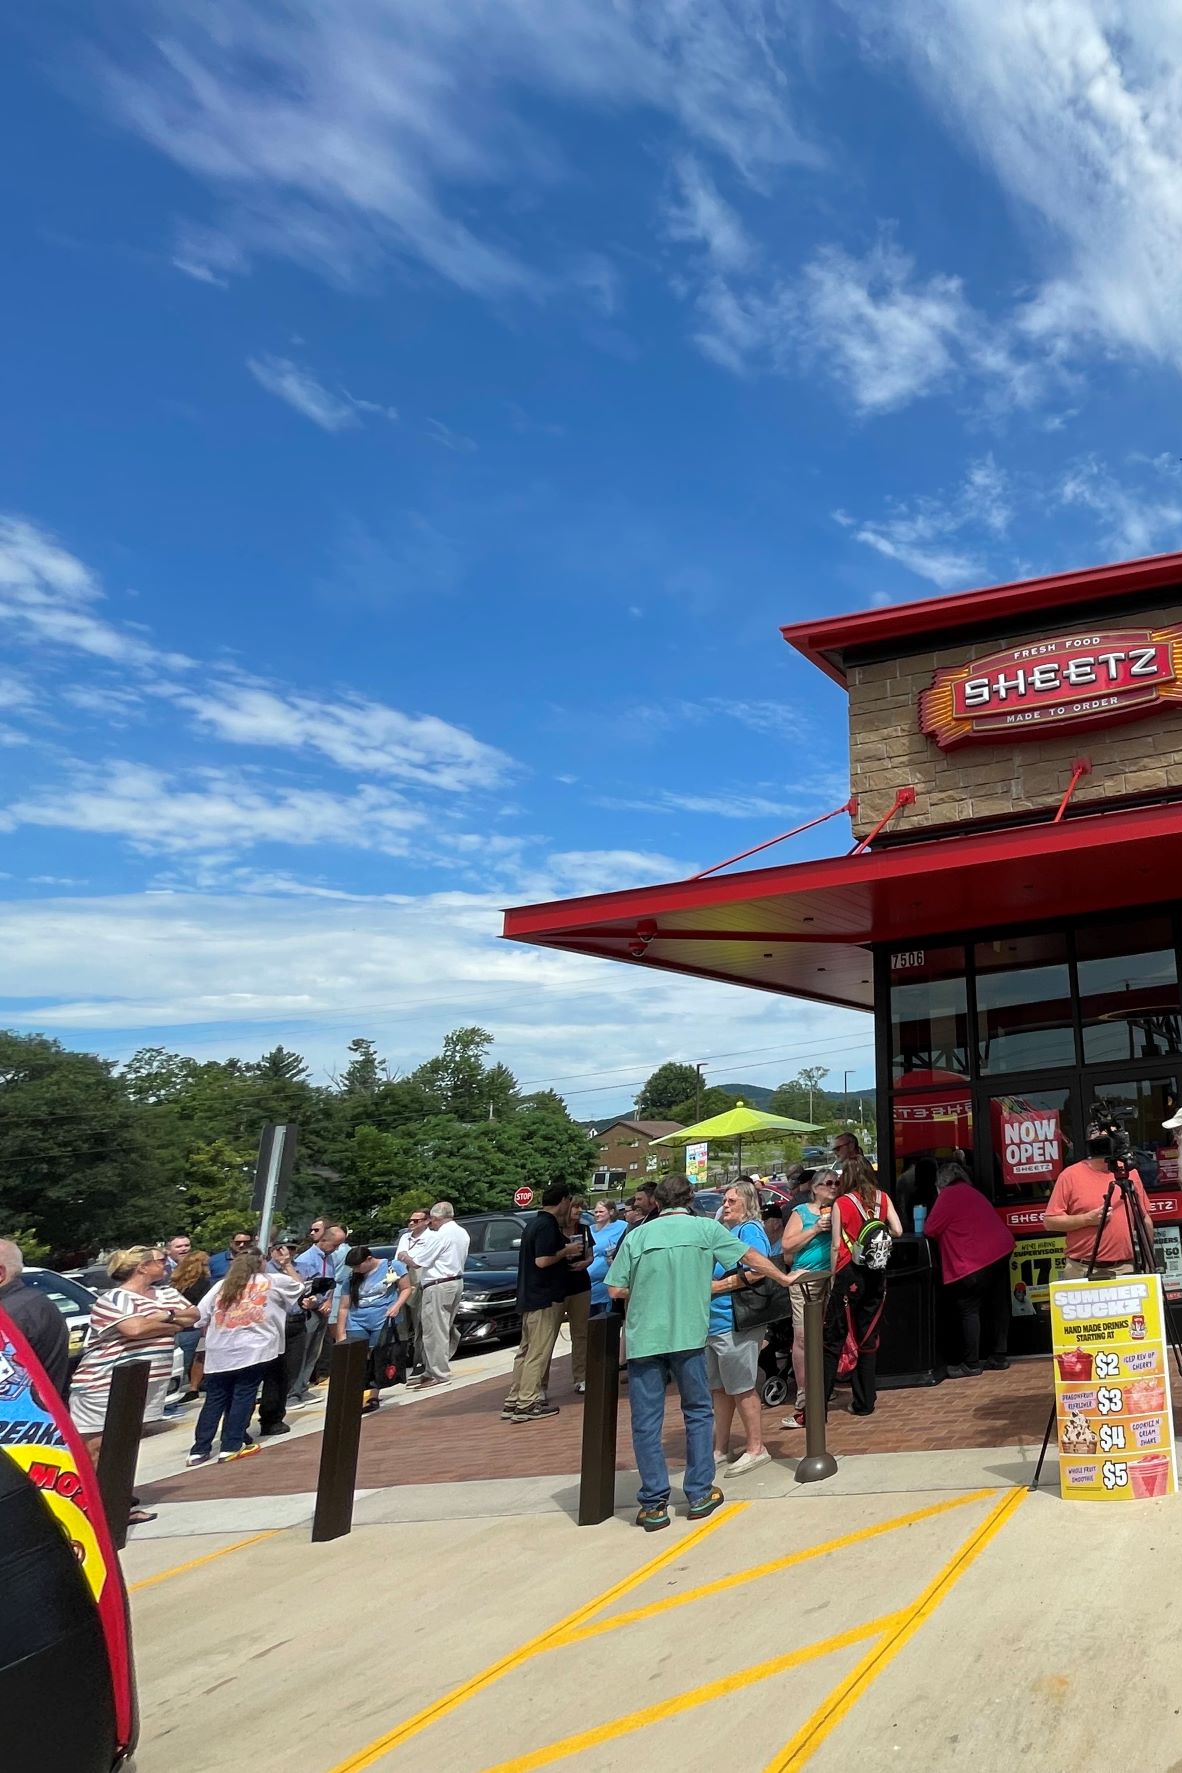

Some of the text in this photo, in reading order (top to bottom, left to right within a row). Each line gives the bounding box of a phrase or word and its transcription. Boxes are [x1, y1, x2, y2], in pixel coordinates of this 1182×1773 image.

[1014, 636, 1101, 660] FRESH FOOD
[964, 647, 1159, 706] SHEETZ
[1006, 696, 1119, 723] MADE TO ORDER
[892, 951, 924, 969] 7506
[1004, 1119, 1057, 1145] NOW
[1005, 1141, 1059, 1165] OPEN
[1014, 1163, 1052, 1173] SHEETZ
[515, 1192, 532, 1201] STOP
[1149, 1201, 1174, 1212] ETZ
[1054, 1284, 1148, 1306] SUMMER
[1062, 1298, 1141, 1320] SUCKZ
[1064, 1320, 1129, 1335] HAND MADE DRINKS
[1076, 1331, 1115, 1342] STARTING AT
[1095, 1351, 1120, 1379] $2
[1123, 1355, 1135, 1364] ICED
[1132, 1360, 1152, 1370] CHERRY
[1097, 1386, 1123, 1416] $3
[1100, 1423, 1126, 1452] $4
[1138, 1429, 1156, 1438] CREAM
[1102, 1460, 1128, 1490] $5
